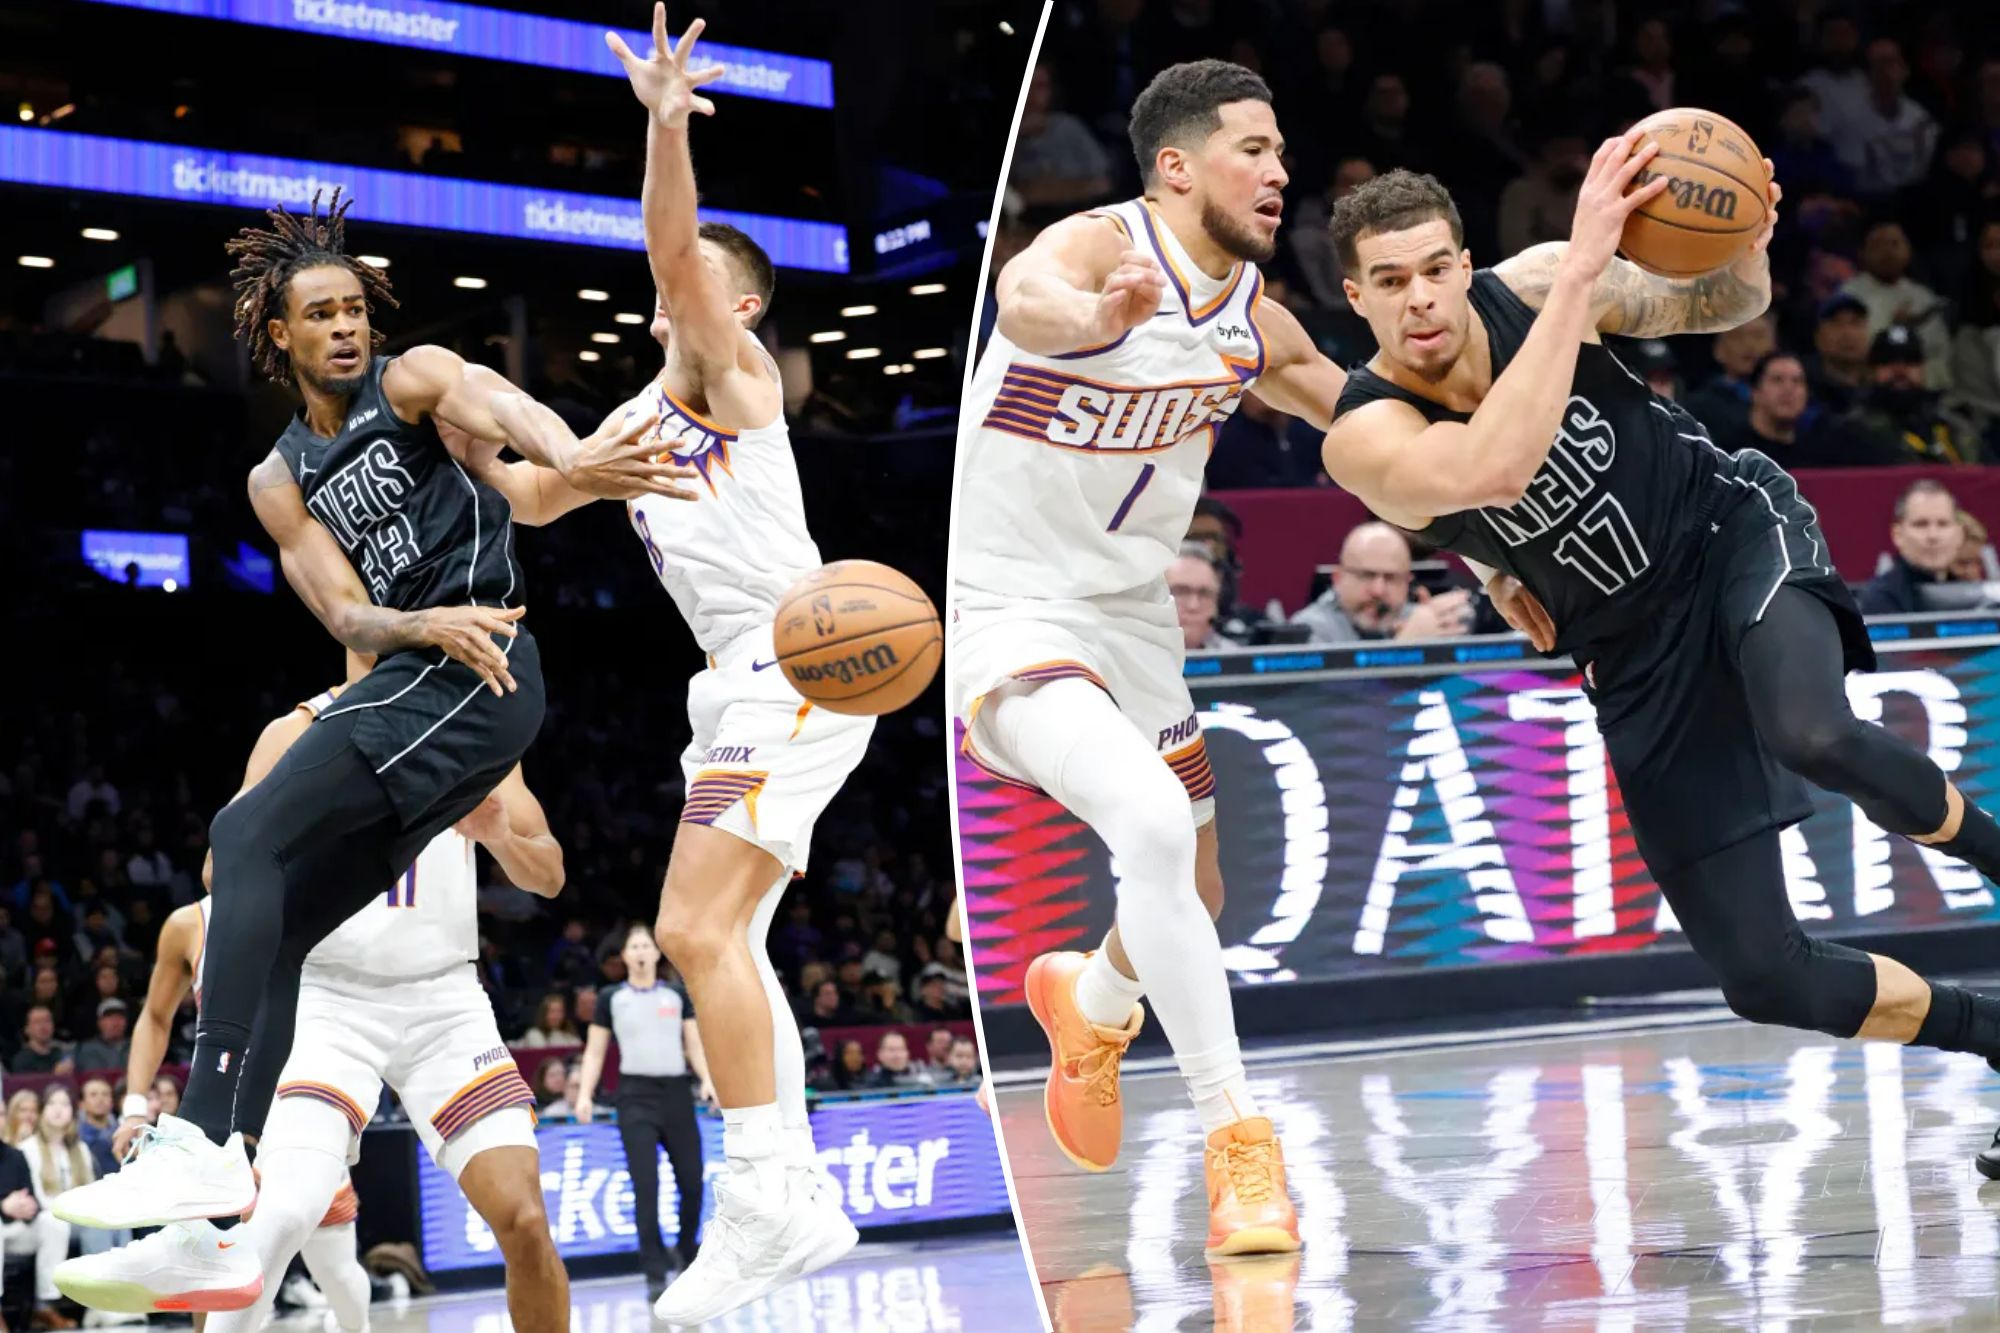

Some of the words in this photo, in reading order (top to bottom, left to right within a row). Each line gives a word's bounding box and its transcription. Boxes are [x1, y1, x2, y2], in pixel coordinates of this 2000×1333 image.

[525, 198, 645, 241] ticketmas
[1216, 321, 1251, 340] ayPa
[1046, 384, 1241, 449] SUNS
[307, 439, 415, 551] NETS
[1106, 463, 1155, 532] 1
[1552, 491, 1650, 596] 17
[791, 642, 899, 684] Wilson
[1110, 669, 1996, 985] QATR
